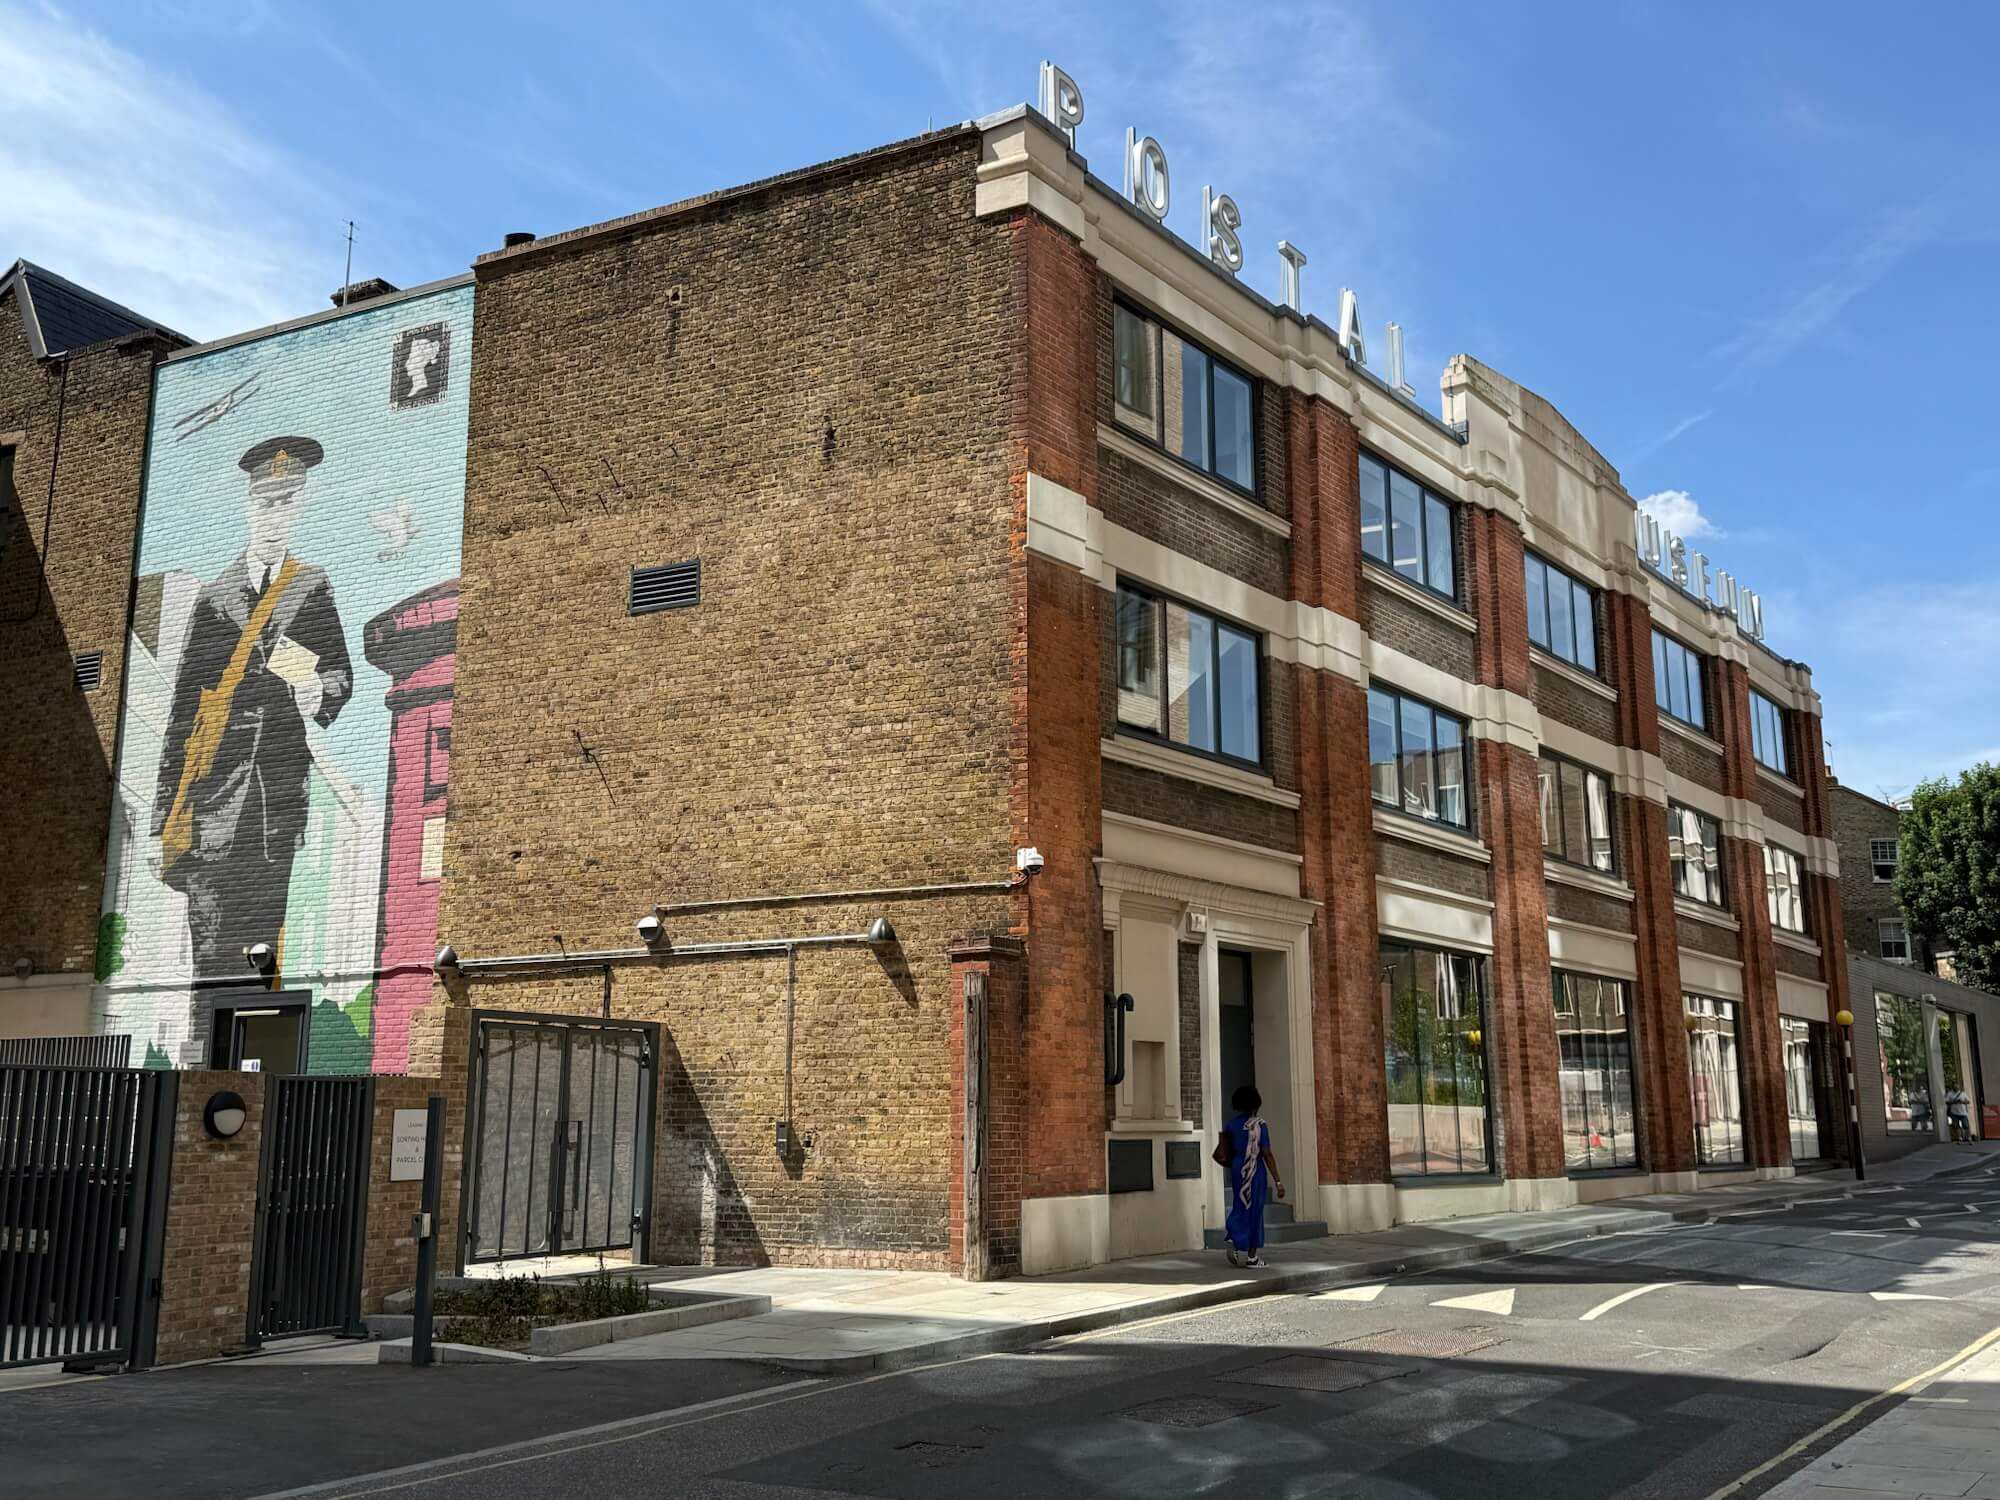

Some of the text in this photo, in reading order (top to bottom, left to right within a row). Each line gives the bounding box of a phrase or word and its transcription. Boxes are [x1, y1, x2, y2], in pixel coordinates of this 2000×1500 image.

[406, 324, 438, 335] POSTAGE
[1043, 62, 1764, 640] POSTAL USEUM
